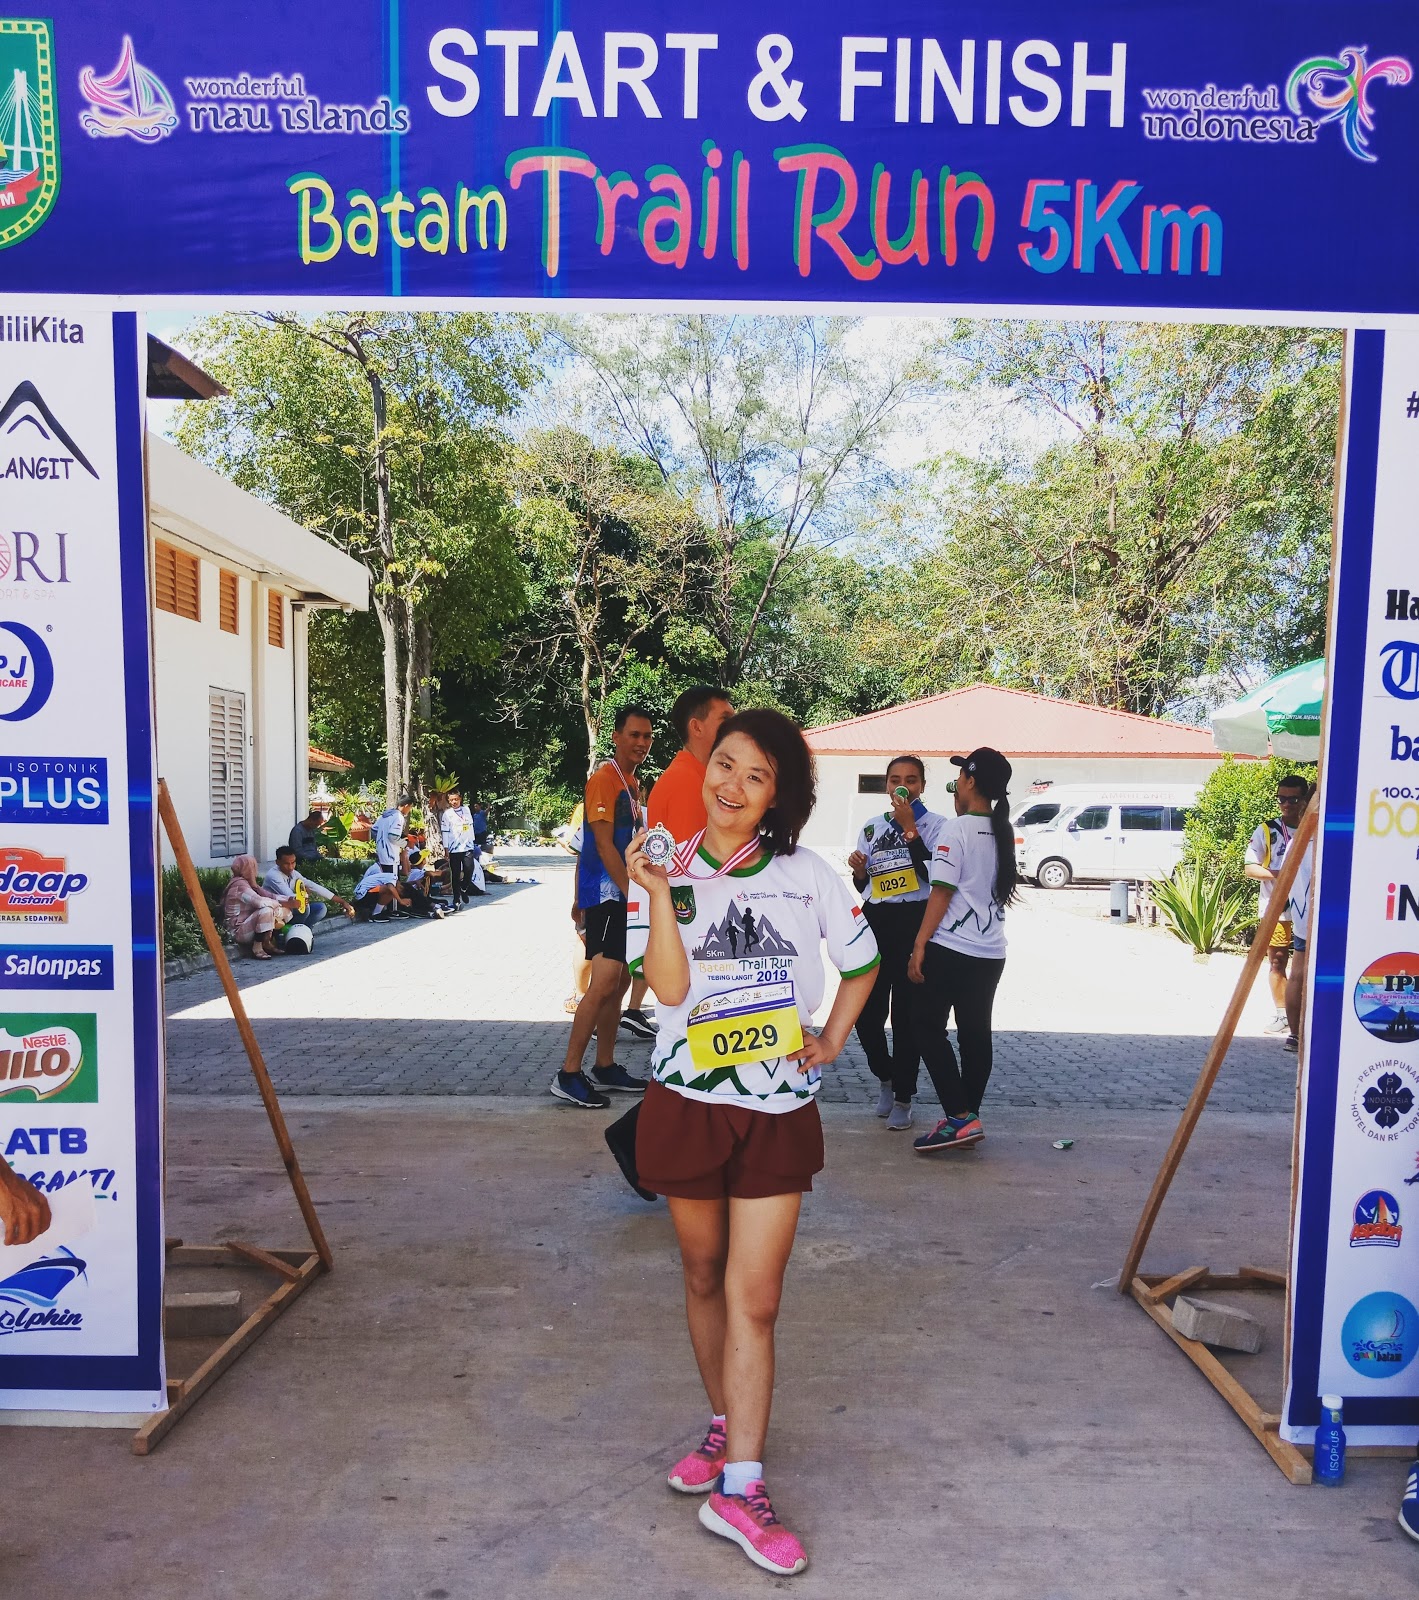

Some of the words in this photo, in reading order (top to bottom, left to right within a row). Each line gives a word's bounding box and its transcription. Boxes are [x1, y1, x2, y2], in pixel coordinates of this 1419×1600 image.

[188, 76, 305, 97] wonderful
[427, 29, 718, 119] START
[748, 34, 808, 122] &
[840, 36, 1127, 128] FINISH
[1146, 86, 1279, 109] wonderful
[190, 106, 270, 130] riau
[281, 99, 408, 132] islands
[1144, 108, 1319, 141] indonesia
[286, 171, 507, 265] Batam
[504, 139, 750, 278] Trail
[773, 142, 996, 281] Run
[1017, 179, 1223, 276] 5Km
[0, 315, 84, 344] iliKita
[9, 762, 98, 774] ISOTONIK
[880, 876, 908, 892] 0292
[8, 895, 56, 905] Instant
[4, 954, 102, 980] Salonpas
[699, 962, 735, 973] Batam
[738, 958, 767, 972] Trail
[769, 957, 793, 970] Run
[706, 950, 725, 958] 5Km
[756, 969, 788, 982] 2019
[712, 1024, 779, 1056] 0229
[4, 1127, 88, 1156] ATB
[1329, 1430, 1340, 1471] ISOPLUS
